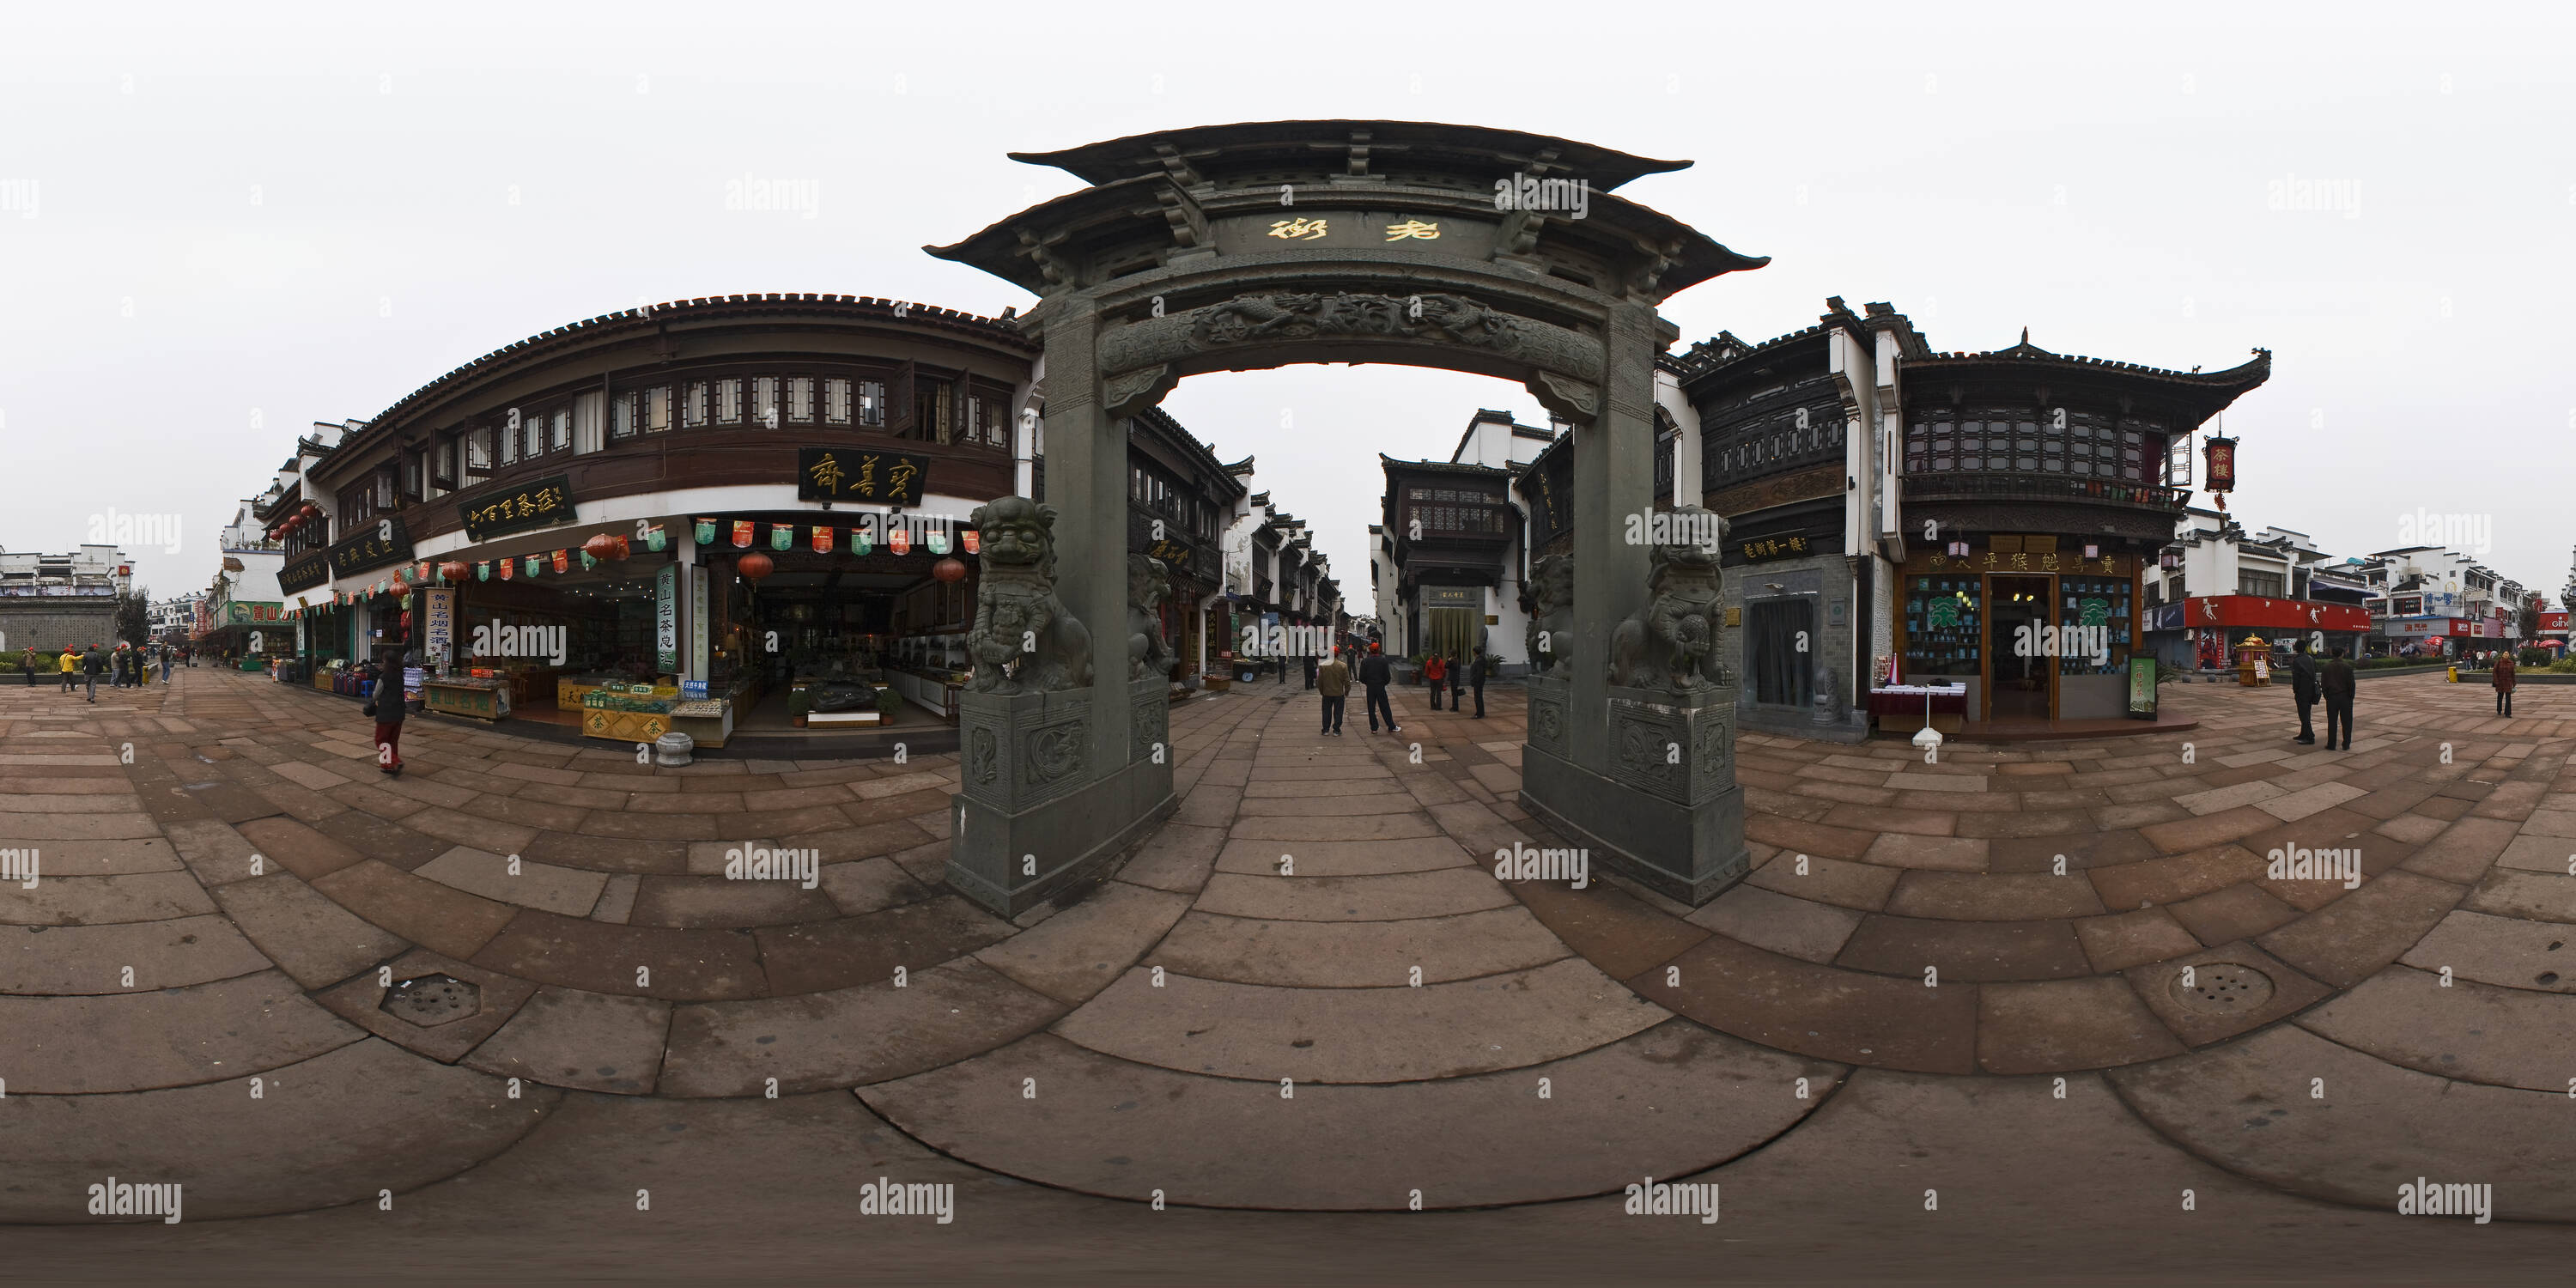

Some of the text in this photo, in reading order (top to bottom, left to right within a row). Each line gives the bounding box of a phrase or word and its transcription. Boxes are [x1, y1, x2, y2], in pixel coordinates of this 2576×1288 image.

[659, 572, 674, 665] 黄山名茶总汇
[592, 715, 605, 730] 茶
[649, 720, 662, 736] 茶
